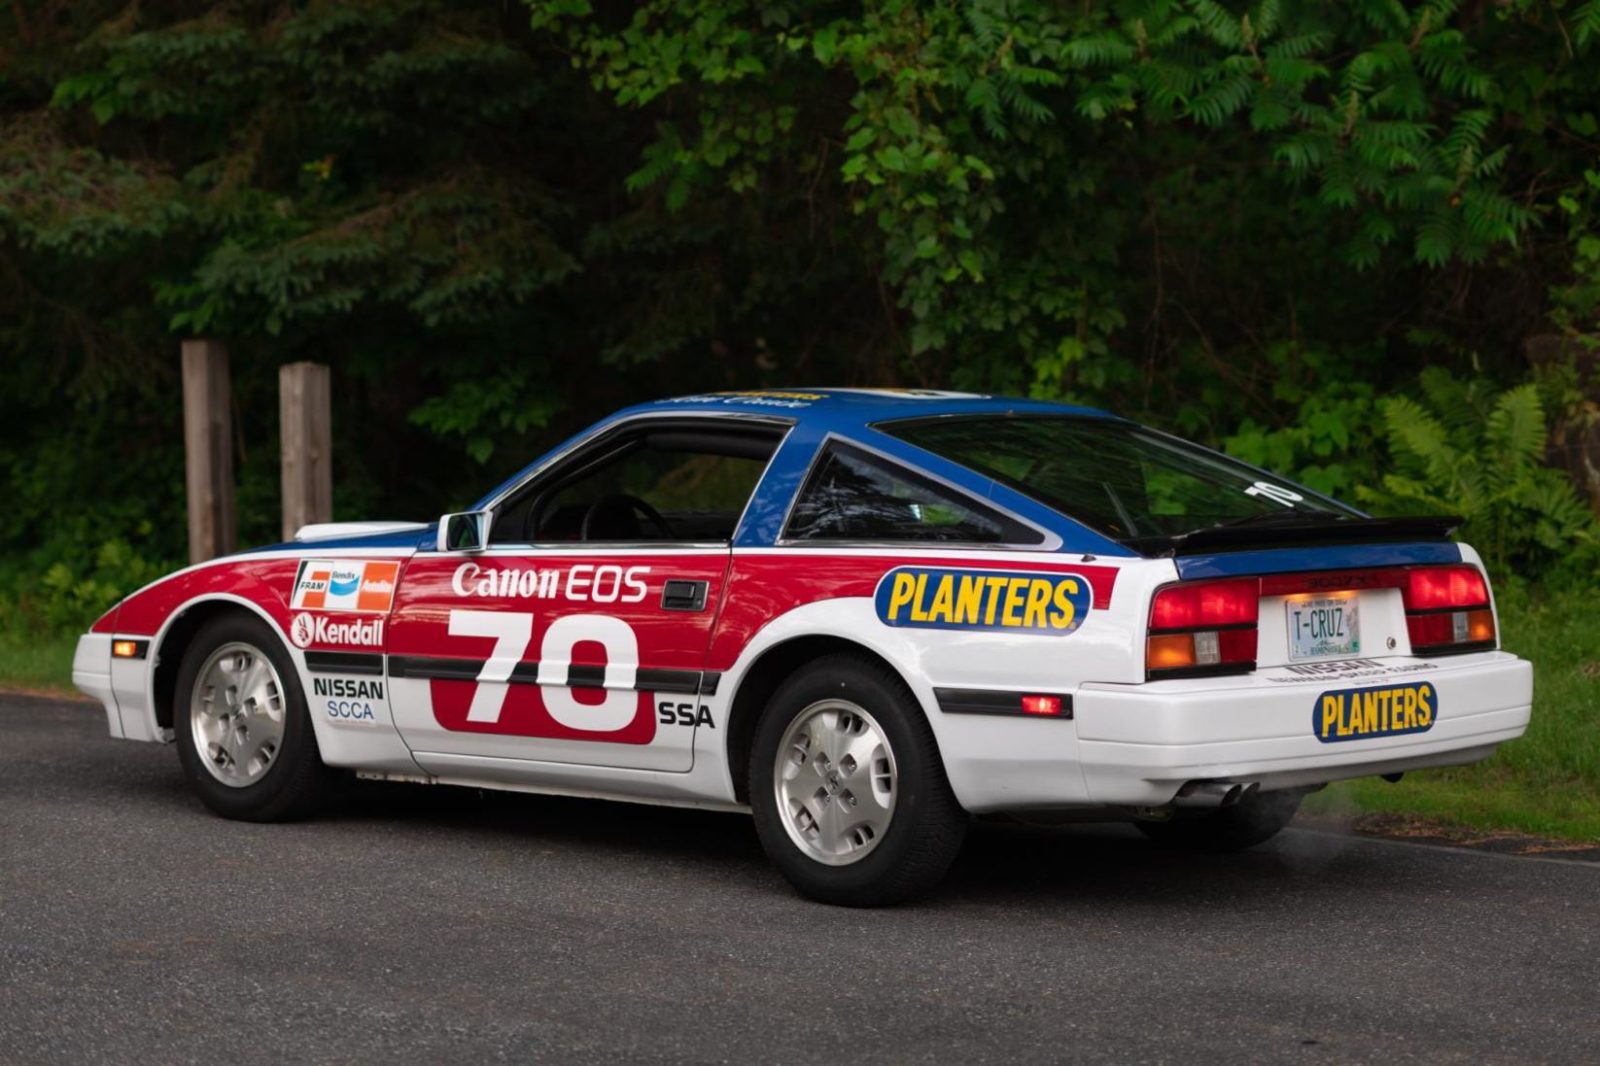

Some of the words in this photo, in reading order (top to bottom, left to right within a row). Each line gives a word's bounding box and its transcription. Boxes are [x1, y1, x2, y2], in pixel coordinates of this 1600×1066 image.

[300, 581, 325, 590] FRAM
[452, 562, 557, 599] Canon
[565, 564, 650, 603] EOS
[887, 572, 1079, 629] PLANTERS
[315, 616, 384, 647] Kendall
[1294, 607, 1345, 641] T-CRUZ
[448, 609, 639, 732] 70
[1285, 658, 1385, 676] NISSAN
[313, 677, 384, 700] NISSAN
[327, 700, 375, 720] SCCA
[658, 701, 716, 729] SSA
[1321, 684, 1432, 738] PLANTERS
